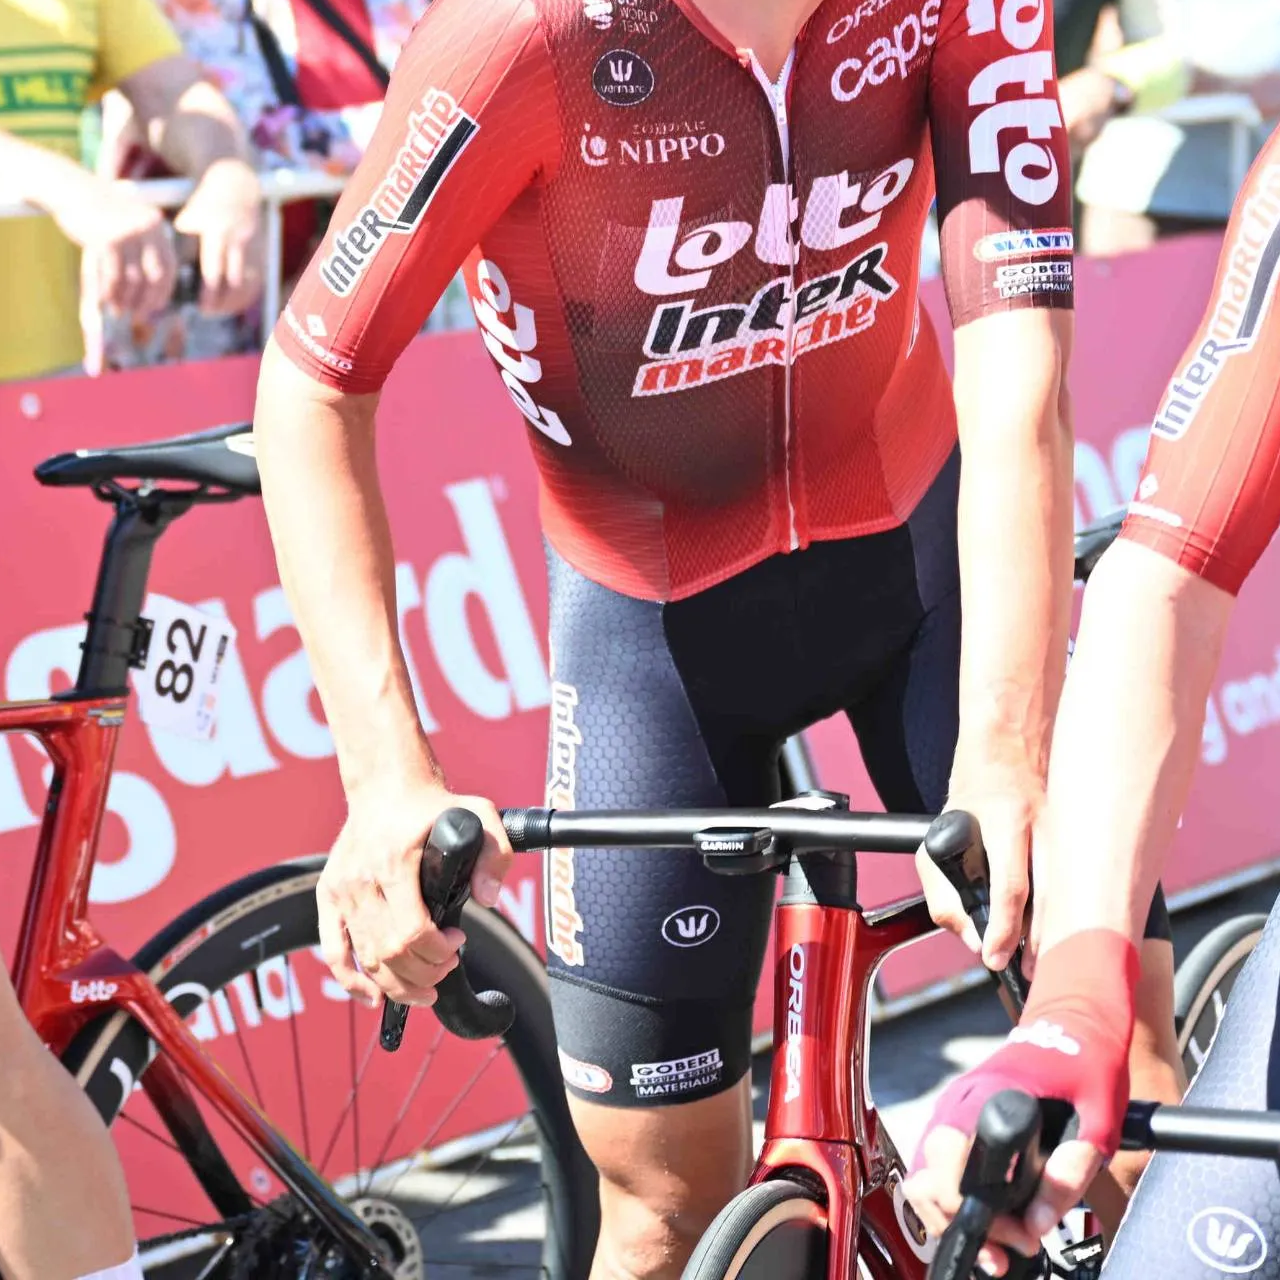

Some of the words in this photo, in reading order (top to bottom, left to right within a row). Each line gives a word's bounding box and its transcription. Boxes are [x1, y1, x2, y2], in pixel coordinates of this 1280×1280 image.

[619, 131, 726, 166] NIPPO
[633, 158, 914, 296] lotto
[471, 258, 573, 447] lotto
[154, 618, 208, 704] 82
[700, 839, 745, 853] GARMIN
[69, 978, 119, 1004] lotto
[784, 942, 808, 1106] ORBEA
[637, 1052, 716, 1076] GOBERT
[638, 1073, 718, 1096] MATERIAUX
